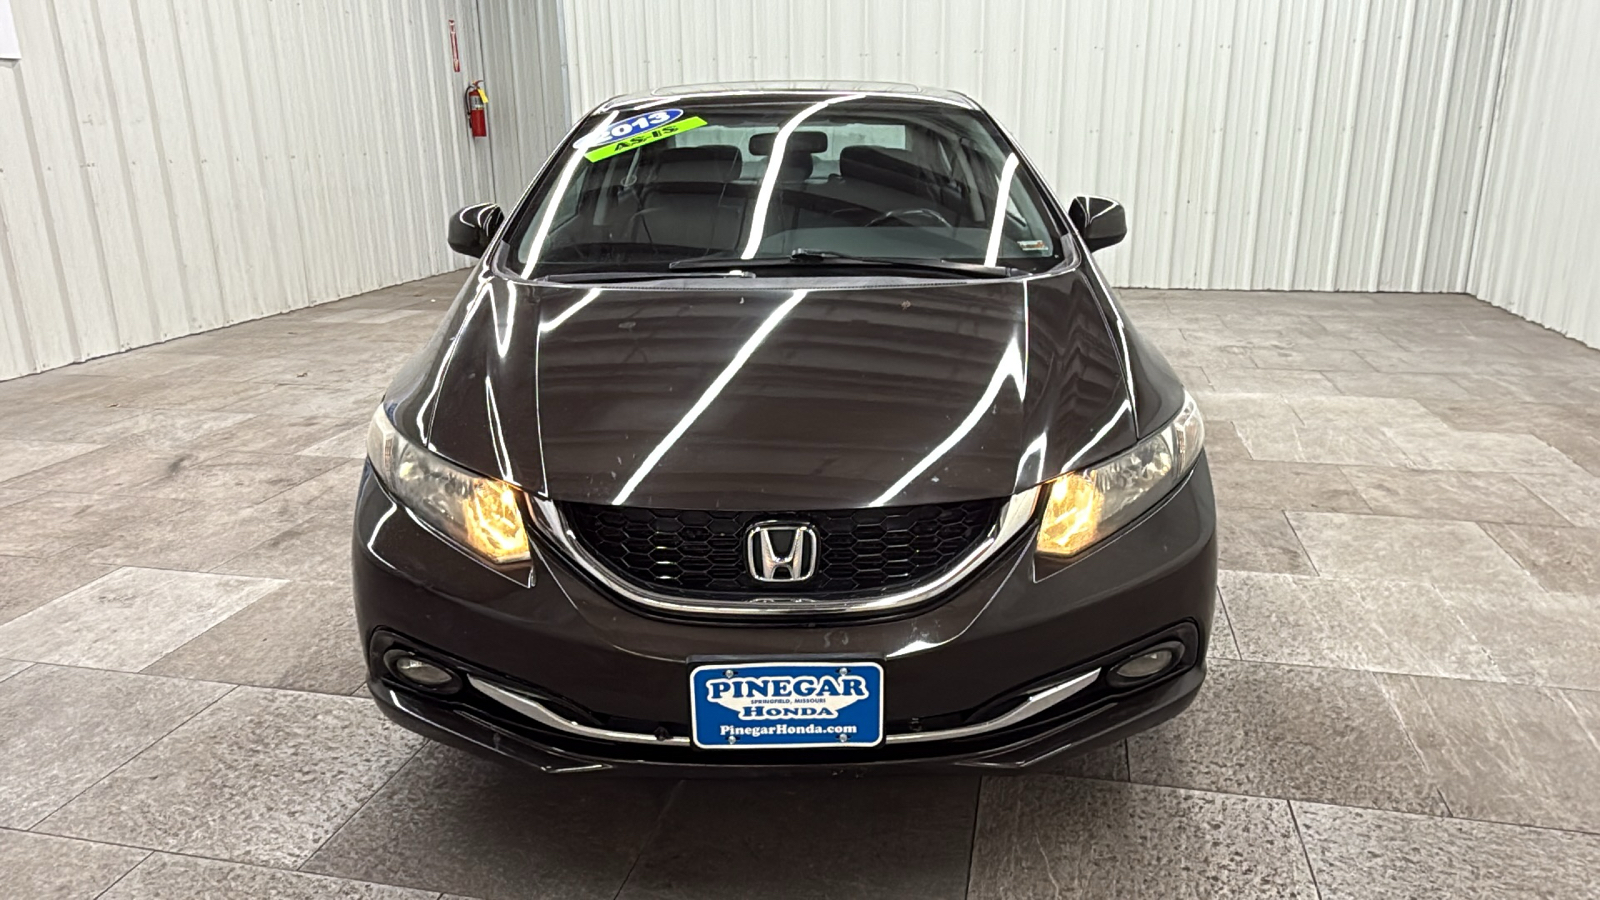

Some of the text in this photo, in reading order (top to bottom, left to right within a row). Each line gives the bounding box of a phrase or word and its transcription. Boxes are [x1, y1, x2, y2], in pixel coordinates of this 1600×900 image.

[614, 125, 679, 152] AS-IS
[710, 679, 865, 699] PINEGAR
[743, 706, 834, 717] HONDA
[720, 724, 857, 737] PinegarHonda.com
